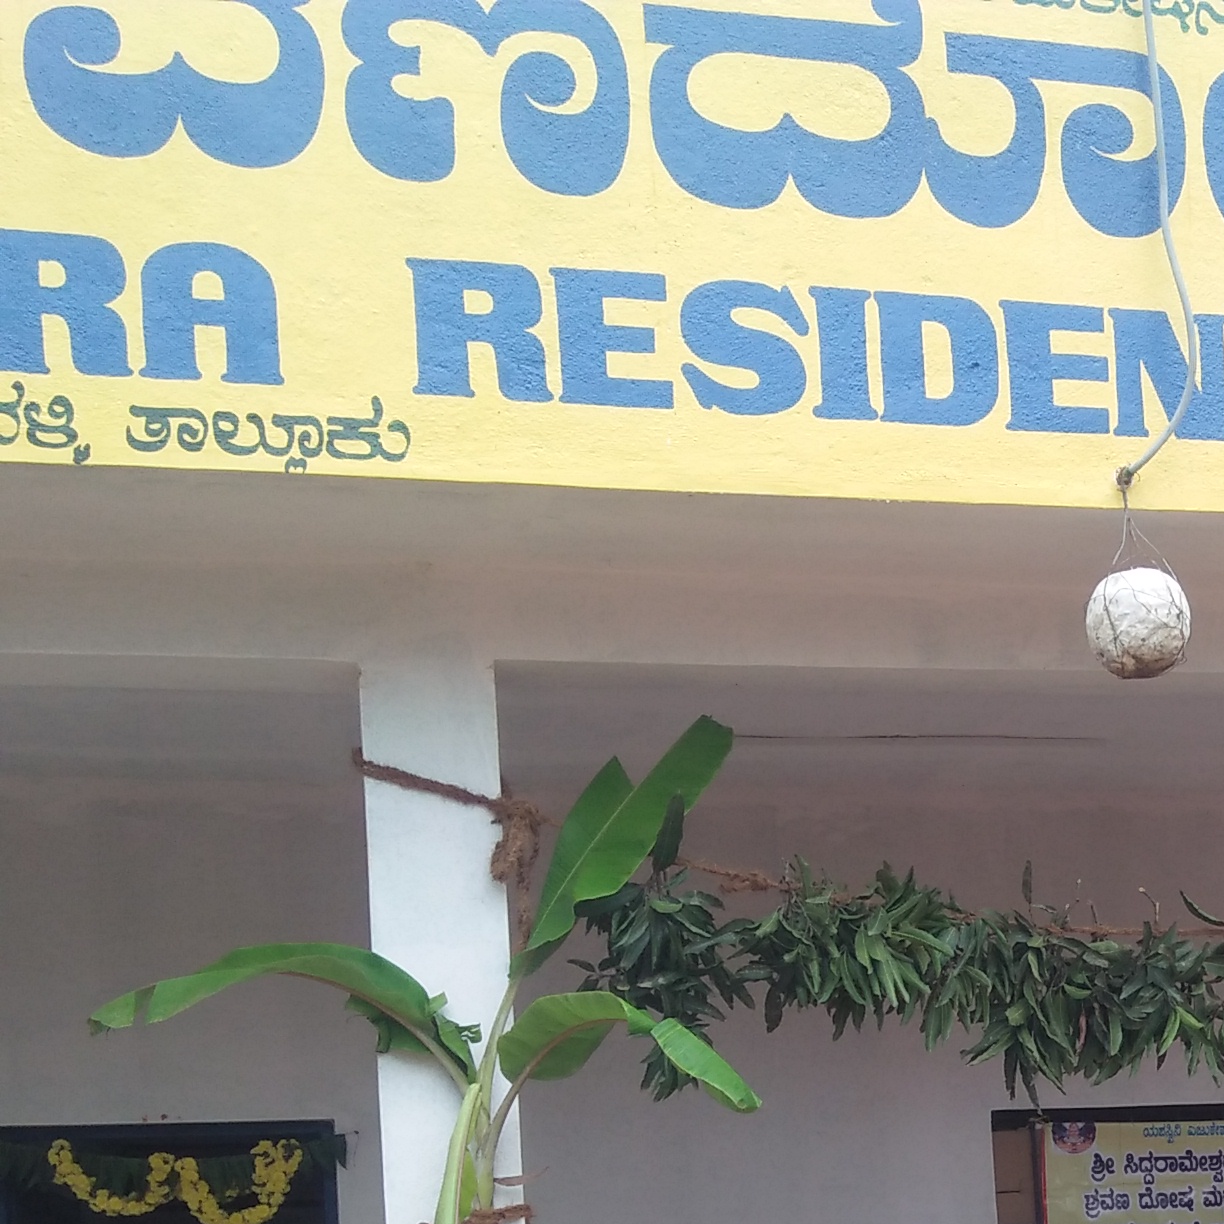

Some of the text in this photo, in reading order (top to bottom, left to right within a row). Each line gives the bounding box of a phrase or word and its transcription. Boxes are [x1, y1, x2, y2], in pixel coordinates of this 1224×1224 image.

[0, 228, 284, 385] RA
[1091, 1152, 1116, 1182] ಶ್ರೀ
[1084, 1187, 1130, 1218] ಶ್ರವಣ
[1138, 1186, 1195, 1212] ದೋಷ
